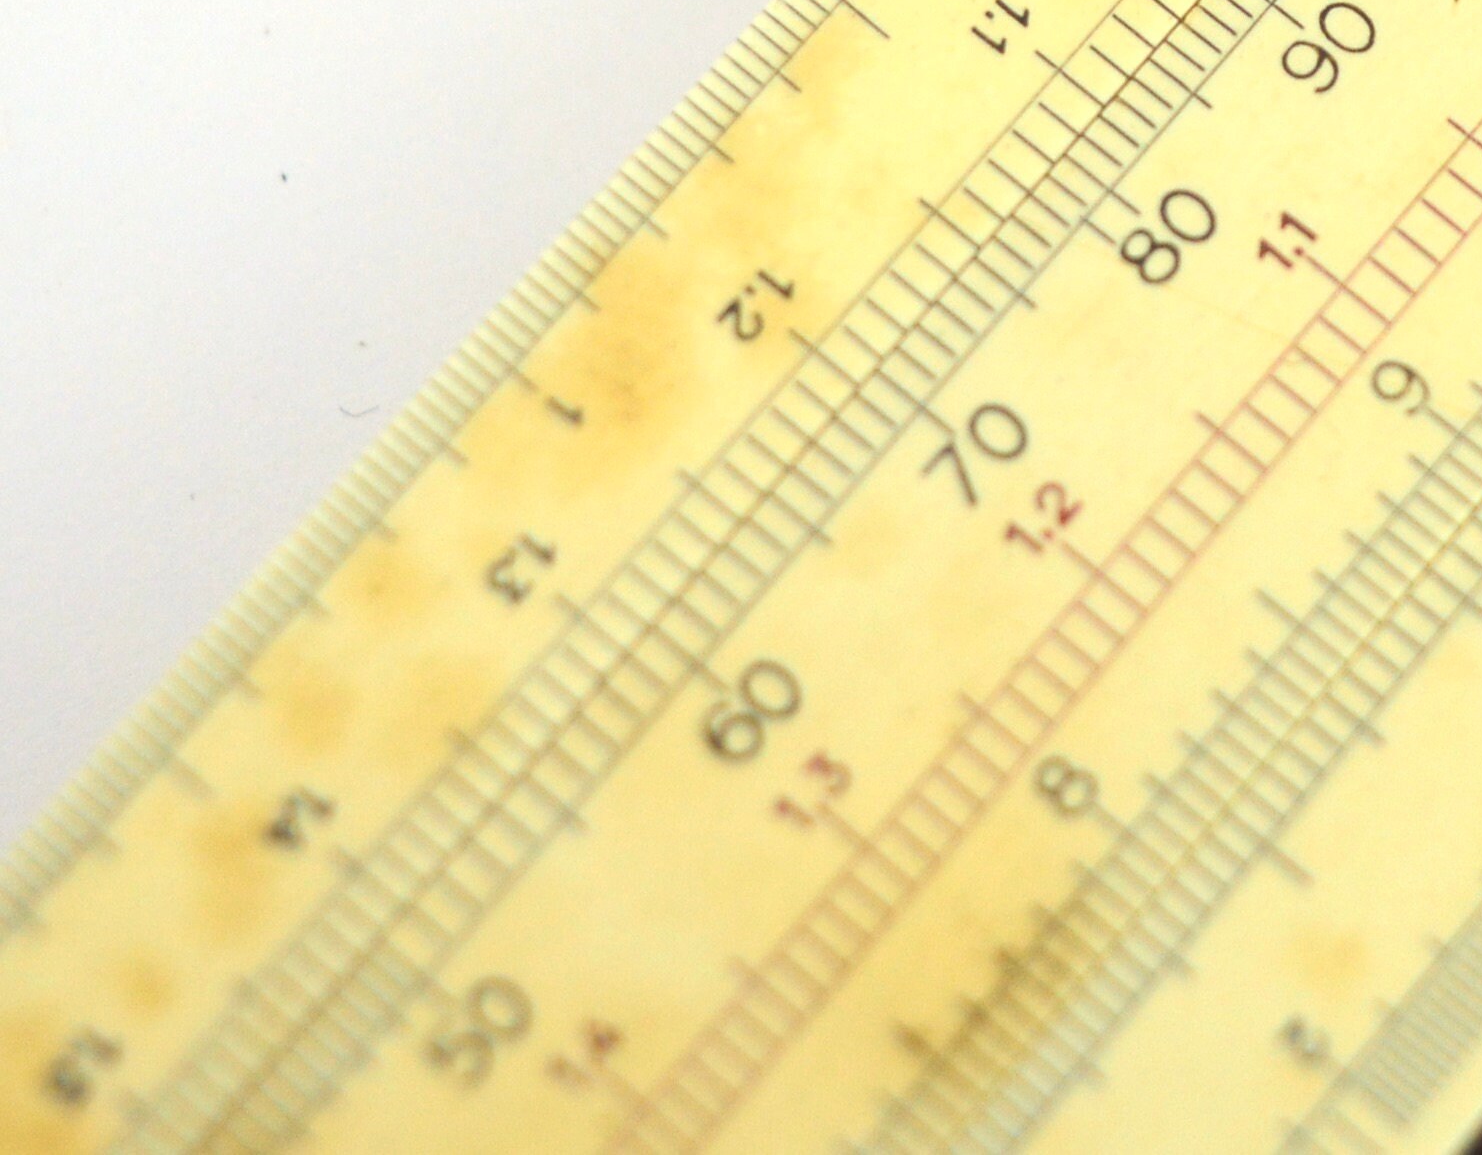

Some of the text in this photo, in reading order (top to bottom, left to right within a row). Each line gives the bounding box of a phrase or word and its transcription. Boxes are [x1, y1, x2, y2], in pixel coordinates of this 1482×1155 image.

[1282, 2, 1376, 93] 90
[1120, 189, 1217, 284] 80
[1258, 212, 1317, 270] 1.1
[717, 269, 795, 342] 1.2
[922, 404, 1029, 507] 70
[1005, 481, 1083, 555] 1.2
[702, 660, 802, 763] 60
[1034, 755, 1099, 818] 8
